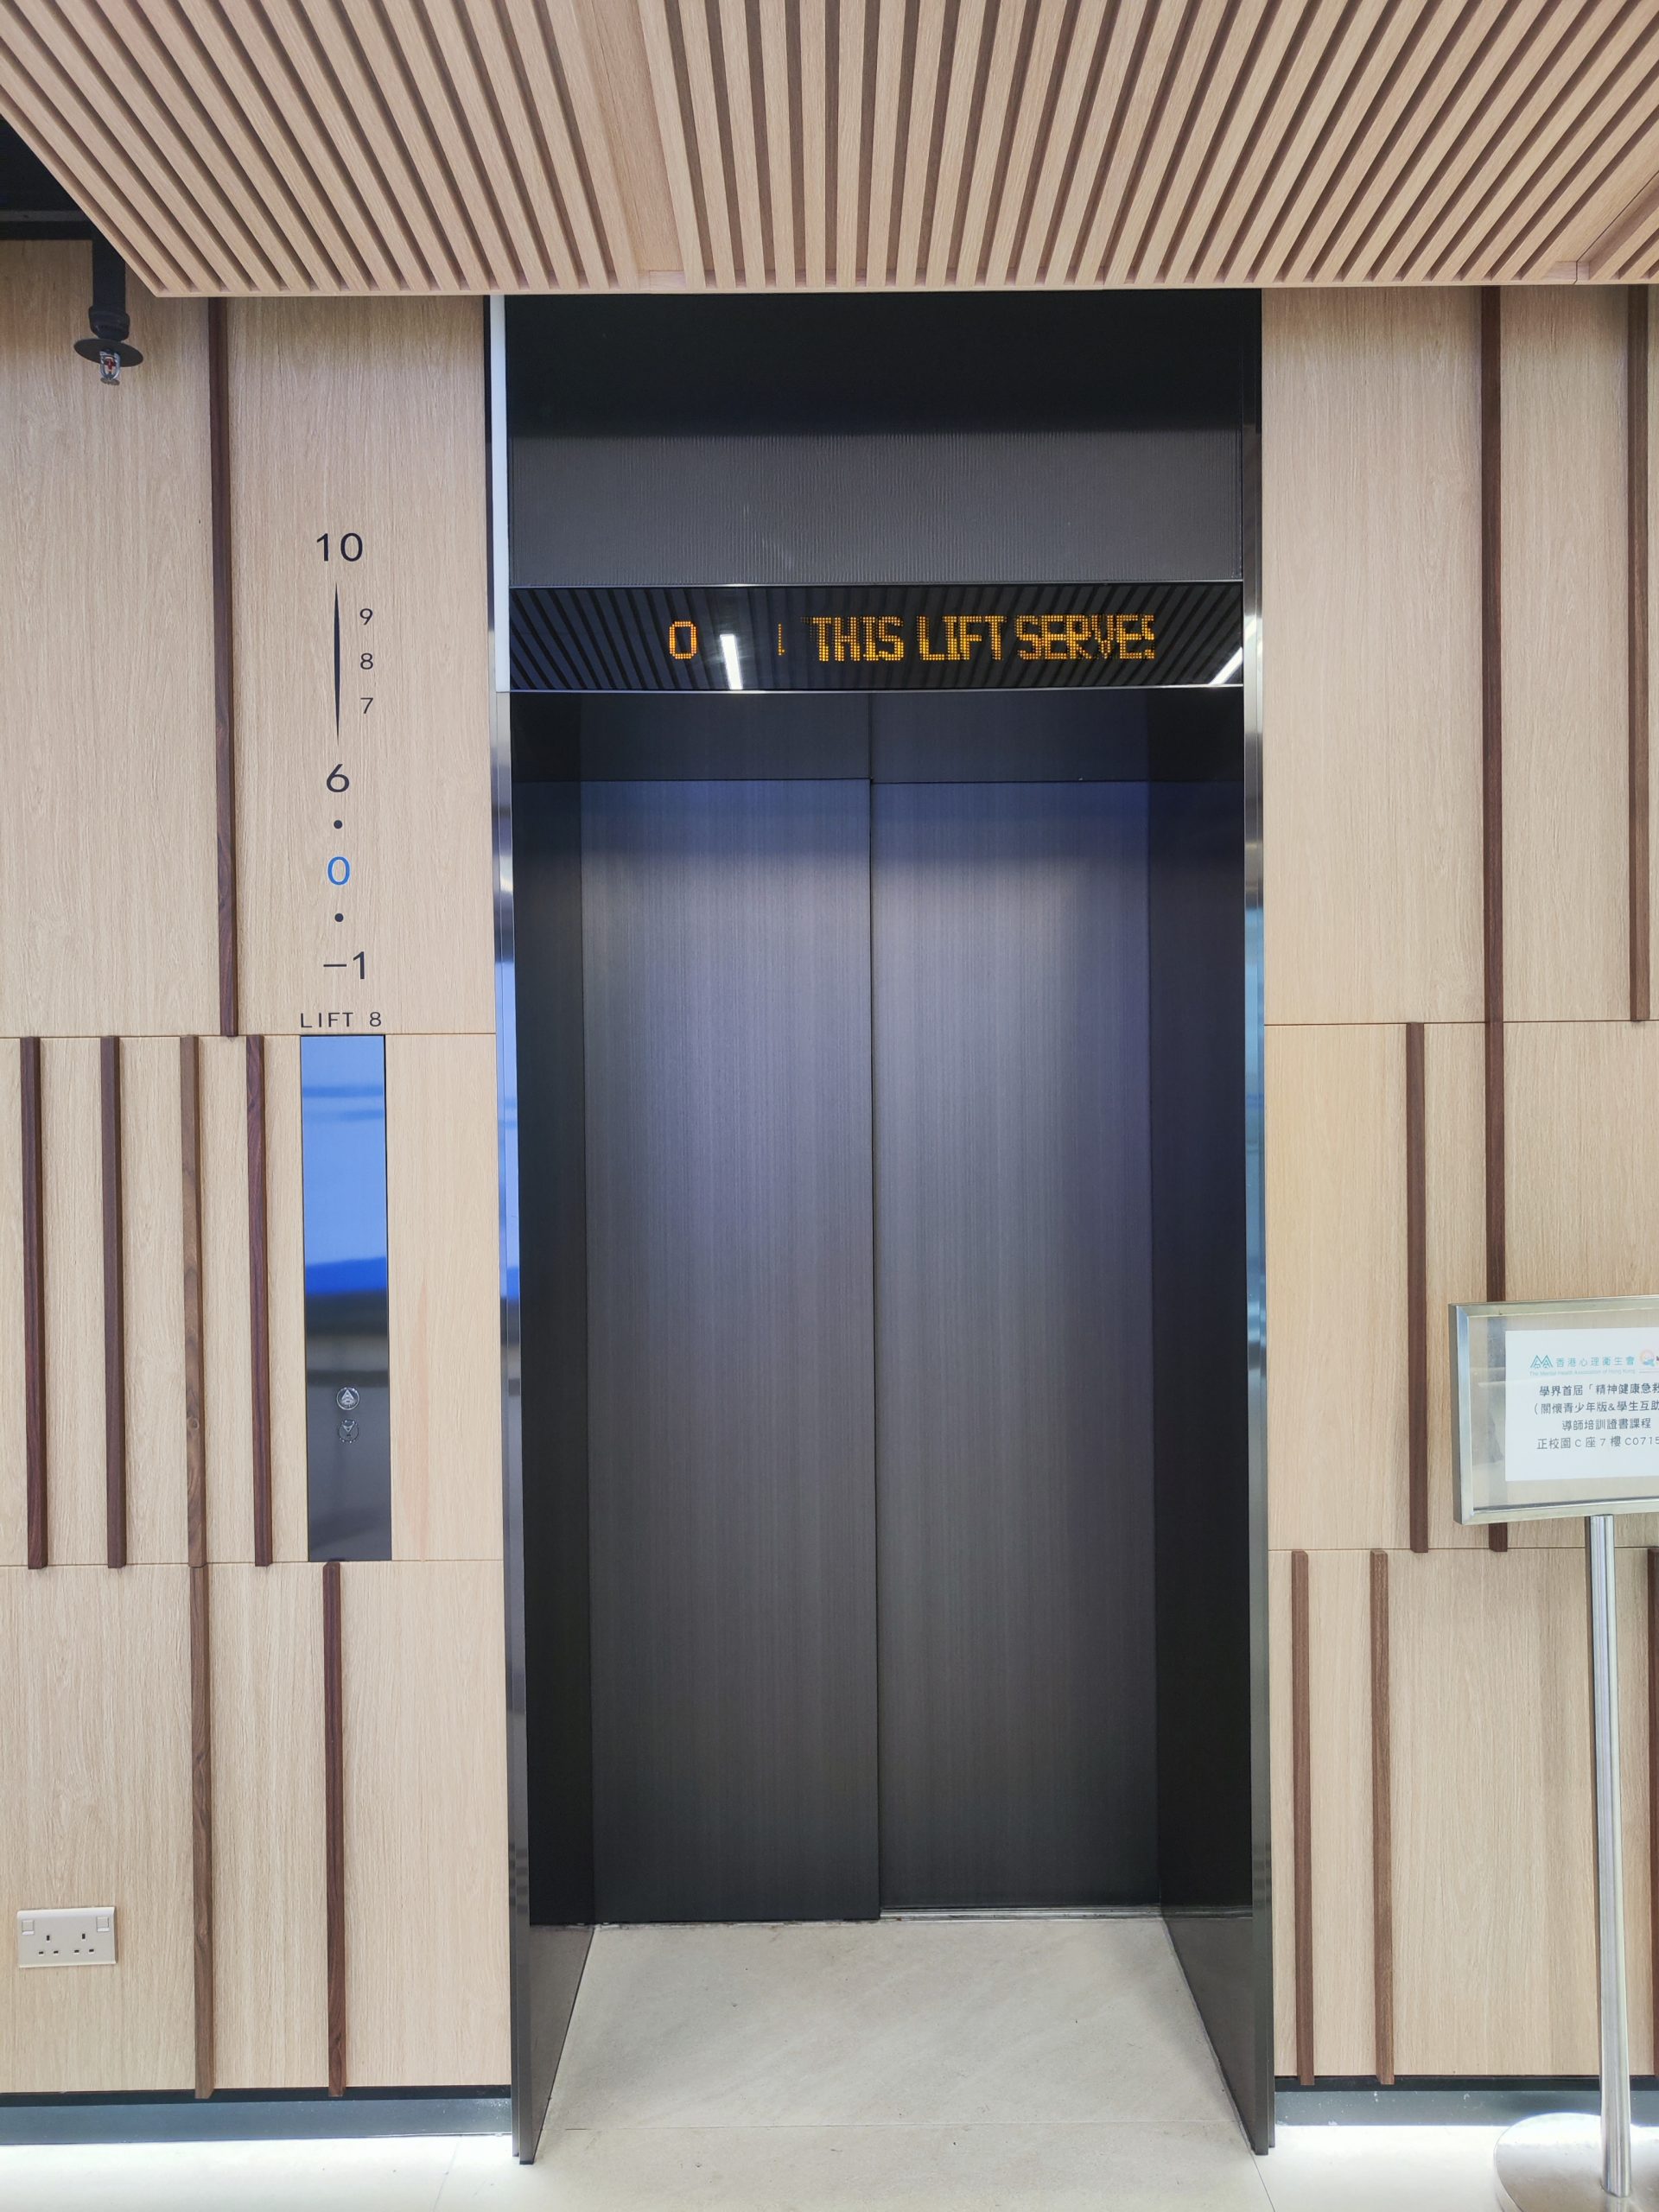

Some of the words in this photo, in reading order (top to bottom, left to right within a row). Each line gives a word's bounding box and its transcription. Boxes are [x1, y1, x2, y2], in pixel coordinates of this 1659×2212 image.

[316, 532, 363, 563] 10
[359, 607, 373, 626] 9
[814, 616, 905, 662] THIS
[917, 615, 1005, 662] LIFT
[359, 652, 374, 671] 8
[359, 697, 374, 715] 7
[326, 763, 351, 793] 6
[327, 855, 352, 886] 0
[300, 1012, 354, 1028] LIFT
[369, 1011, 382, 1027] 8
[1555, 1355, 1635, 1368] 香港心理衛生會
[1561, 1418, 1651, 1432] 導師培訓證書課程
